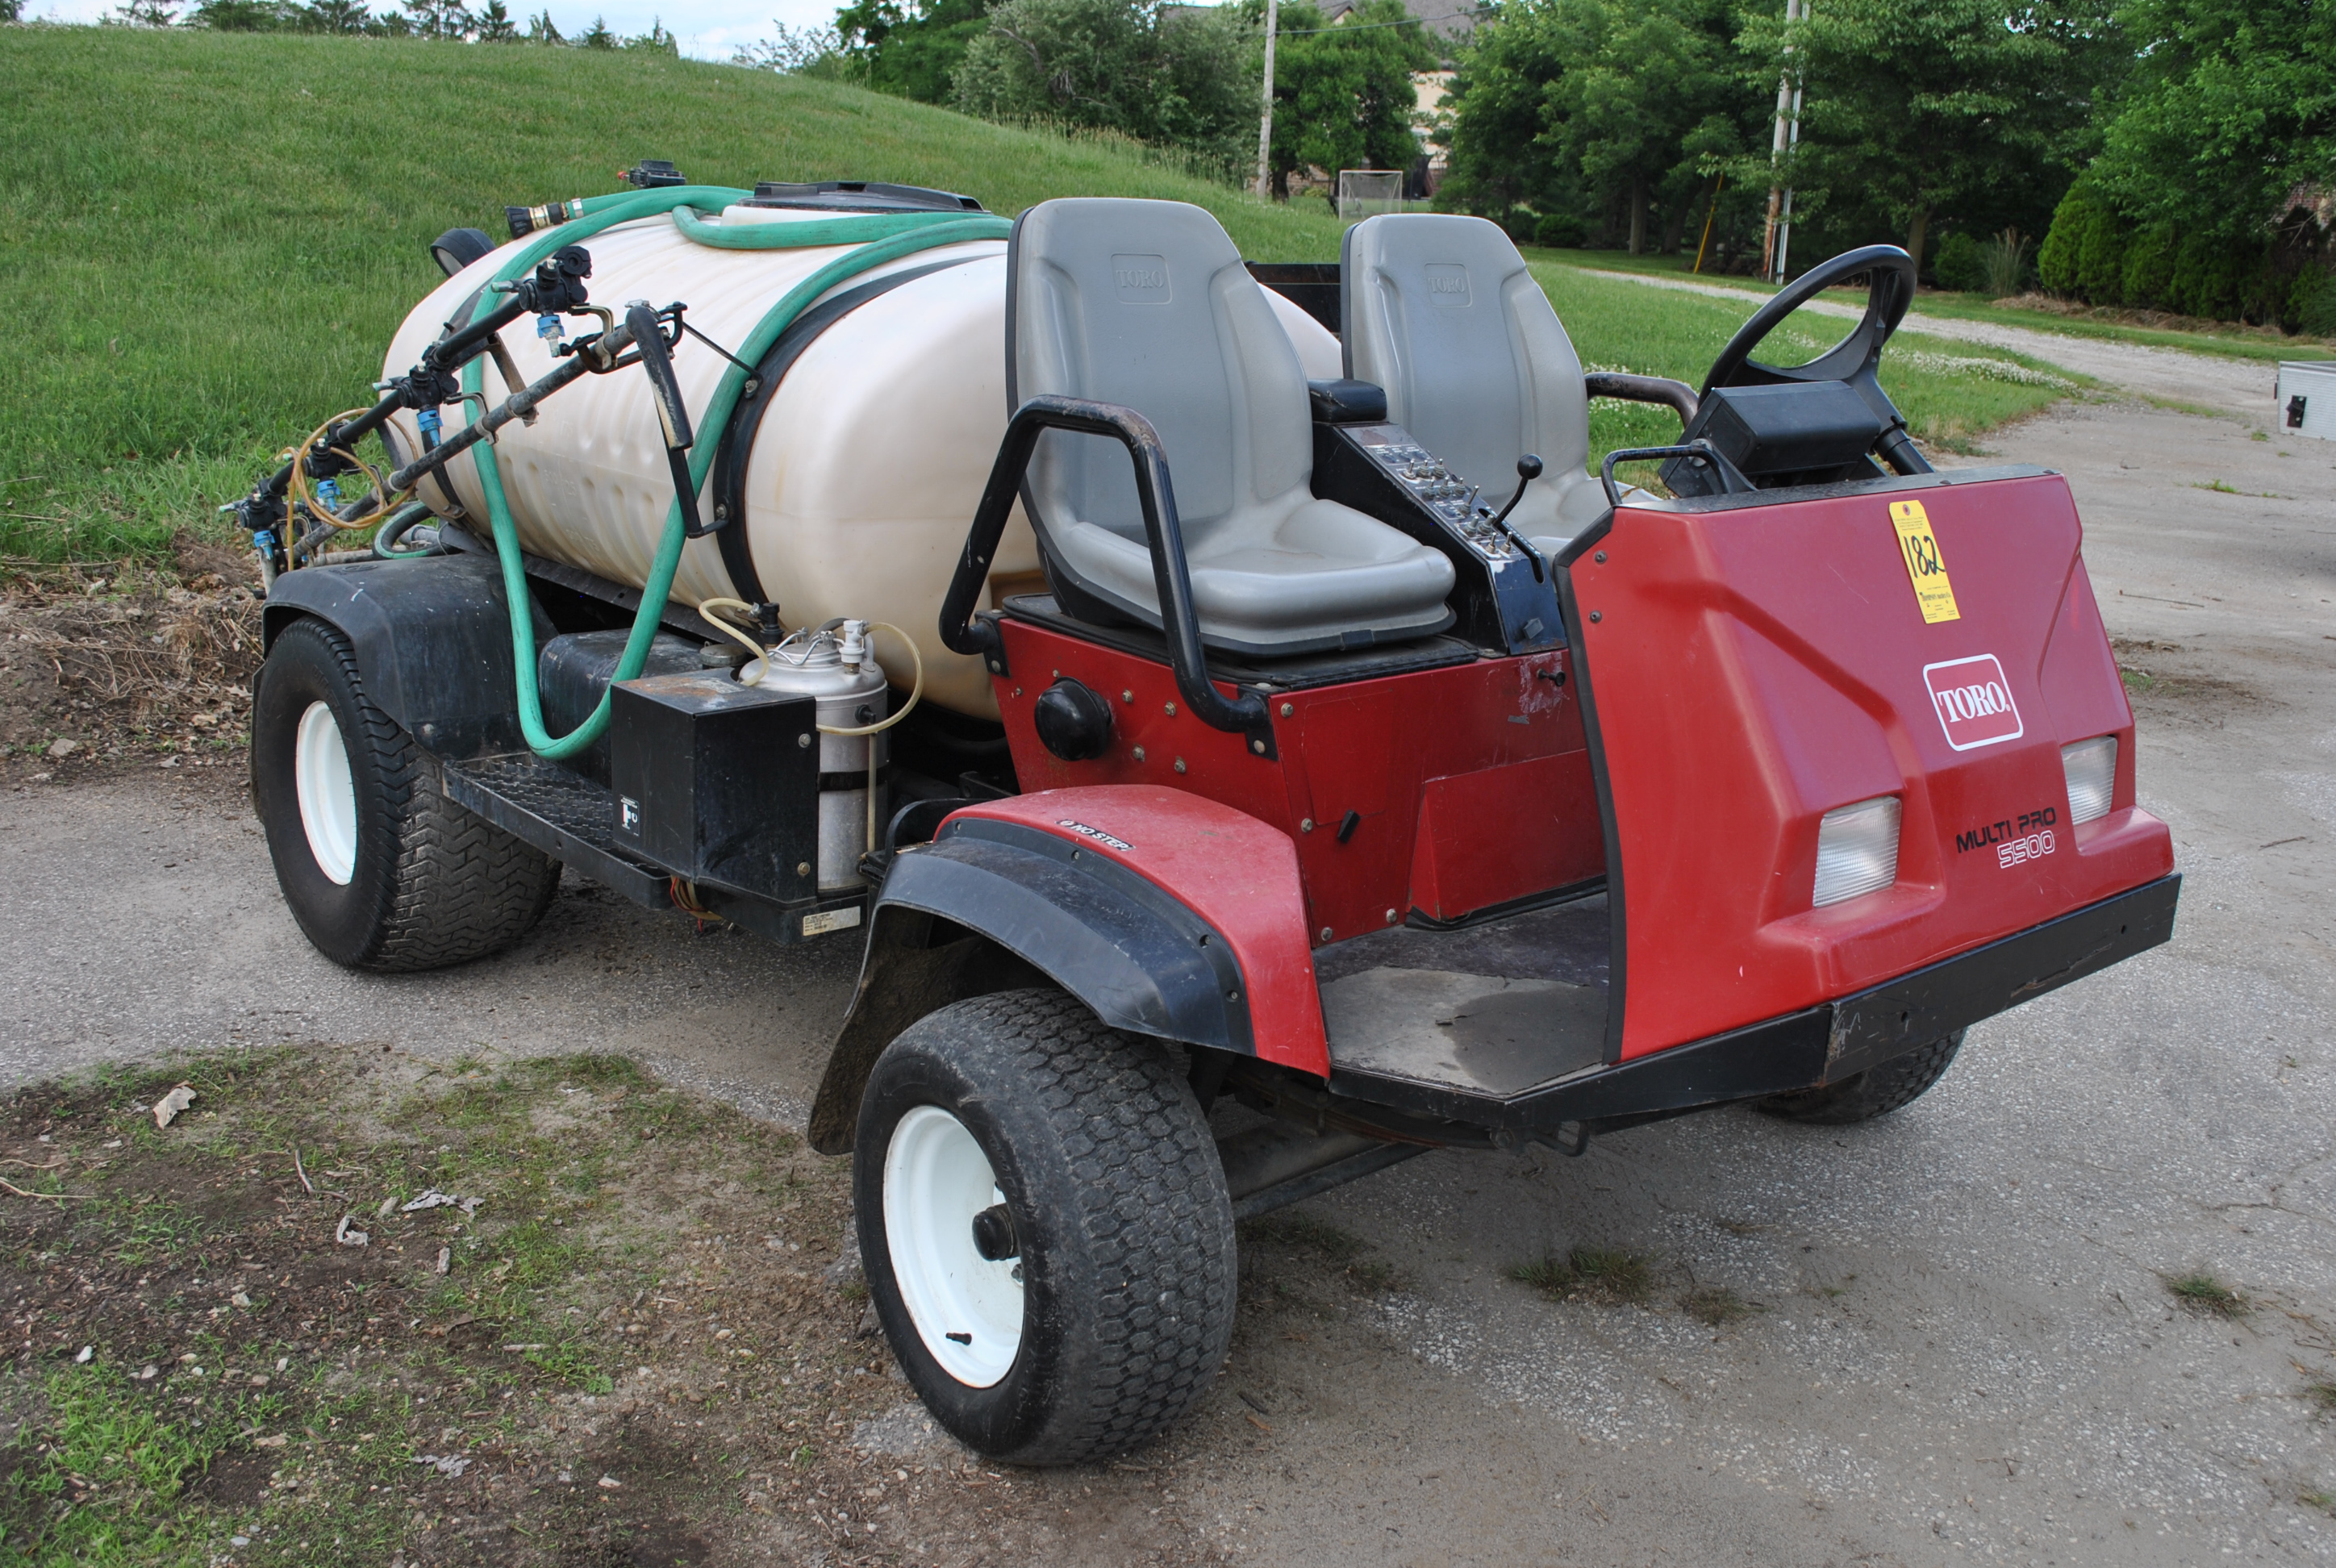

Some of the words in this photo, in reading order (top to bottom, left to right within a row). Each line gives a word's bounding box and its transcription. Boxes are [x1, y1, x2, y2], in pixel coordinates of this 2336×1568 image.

[1116, 269, 1165, 288] TORO
[1428, 277, 1465, 294] TORO
[1903, 535, 1946, 578] 182
[1937, 682, 2007, 723] TORO
[1070, 824, 1095, 834] NO
[1092, 832, 1129, 849] STEP
[1956, 820, 2013, 853] MULTI
[2017, 807, 2057, 834] PRO
[1997, 830, 2055, 869] 5500
